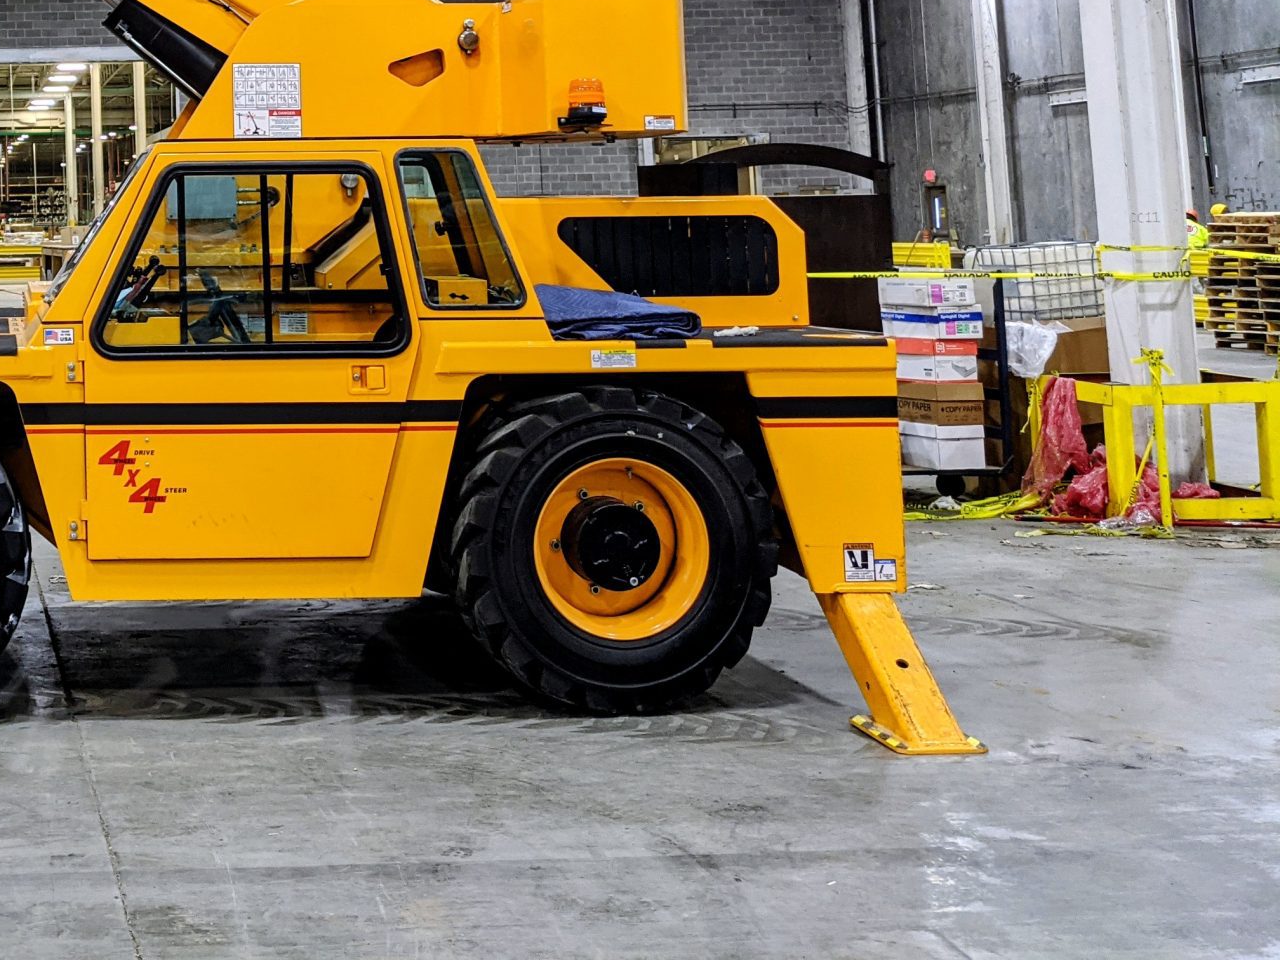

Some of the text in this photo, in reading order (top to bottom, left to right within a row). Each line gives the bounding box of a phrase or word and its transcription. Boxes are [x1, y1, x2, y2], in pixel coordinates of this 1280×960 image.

[1152, 271, 1192, 279] CAUTIO
[899, 400, 932, 412] OPY PAPER
[98, 440, 136, 475] 4
[128, 478, 167, 513] 4
